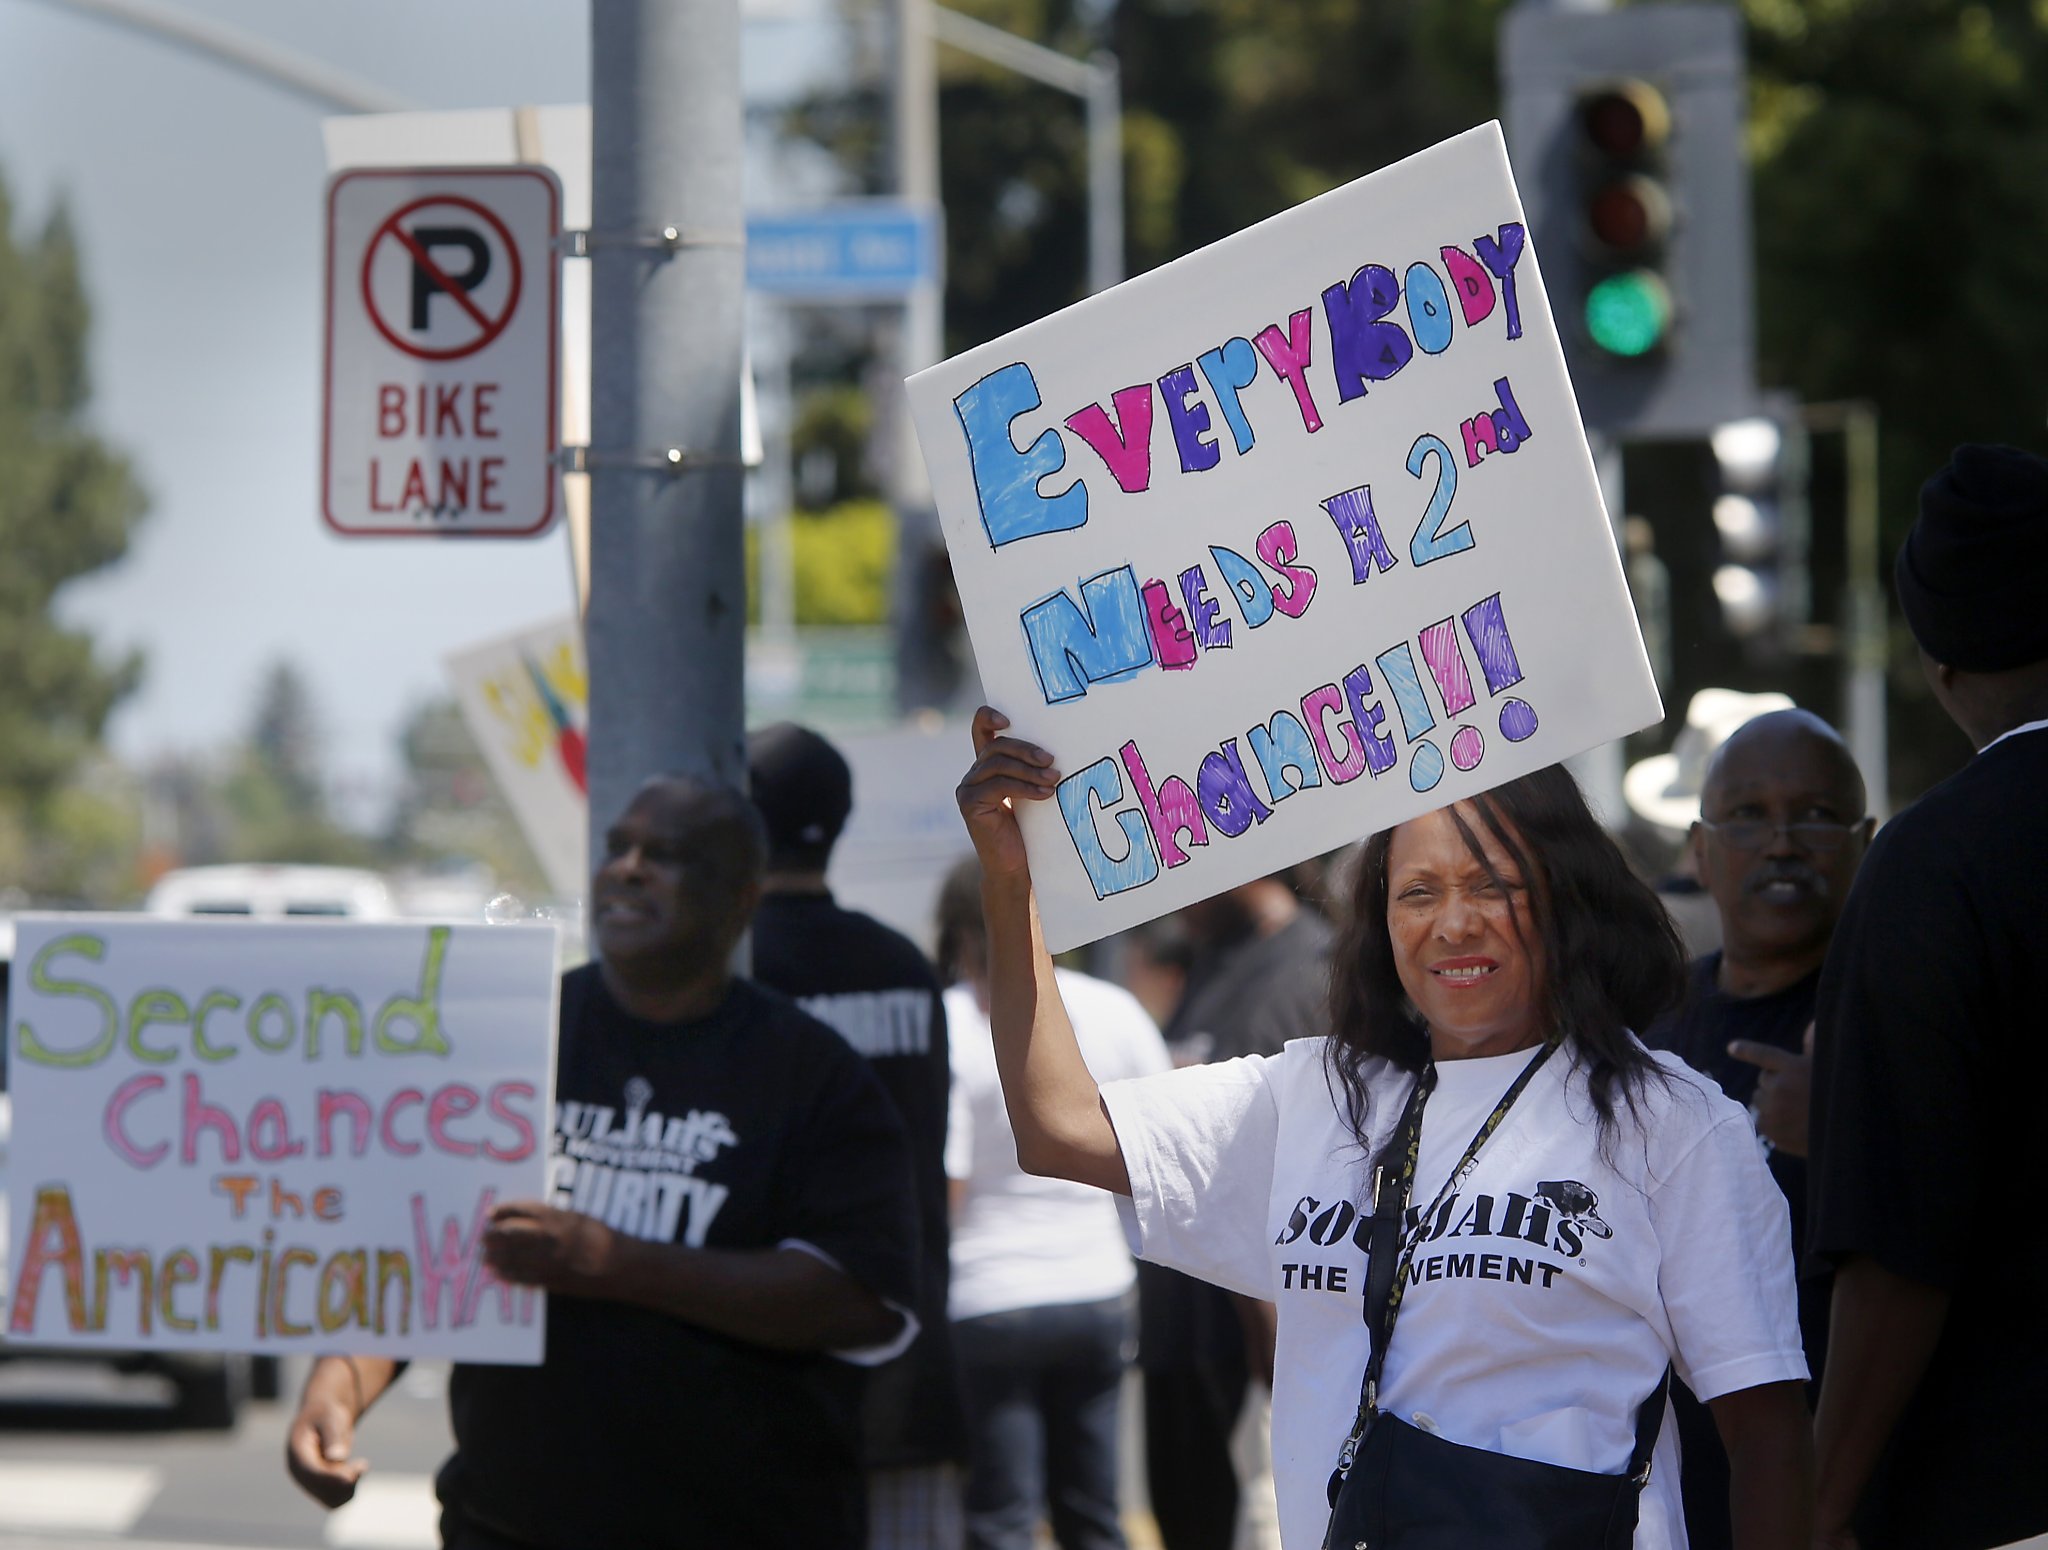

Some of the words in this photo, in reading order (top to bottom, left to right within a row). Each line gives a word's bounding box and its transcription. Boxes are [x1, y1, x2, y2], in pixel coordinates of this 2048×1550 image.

[378, 383, 500, 439] BIKE
[368, 457, 505, 512] LANE
[1018, 520, 1317, 705] NEEDS
[1319, 484, 1399, 585] A
[17, 926, 452, 1068] Second
[105, 1073, 537, 1170] Chances
[216, 1175, 346, 1222] The
[9, 1184, 413, 1341] American
[1281, 1263, 1348, 1293] THE
